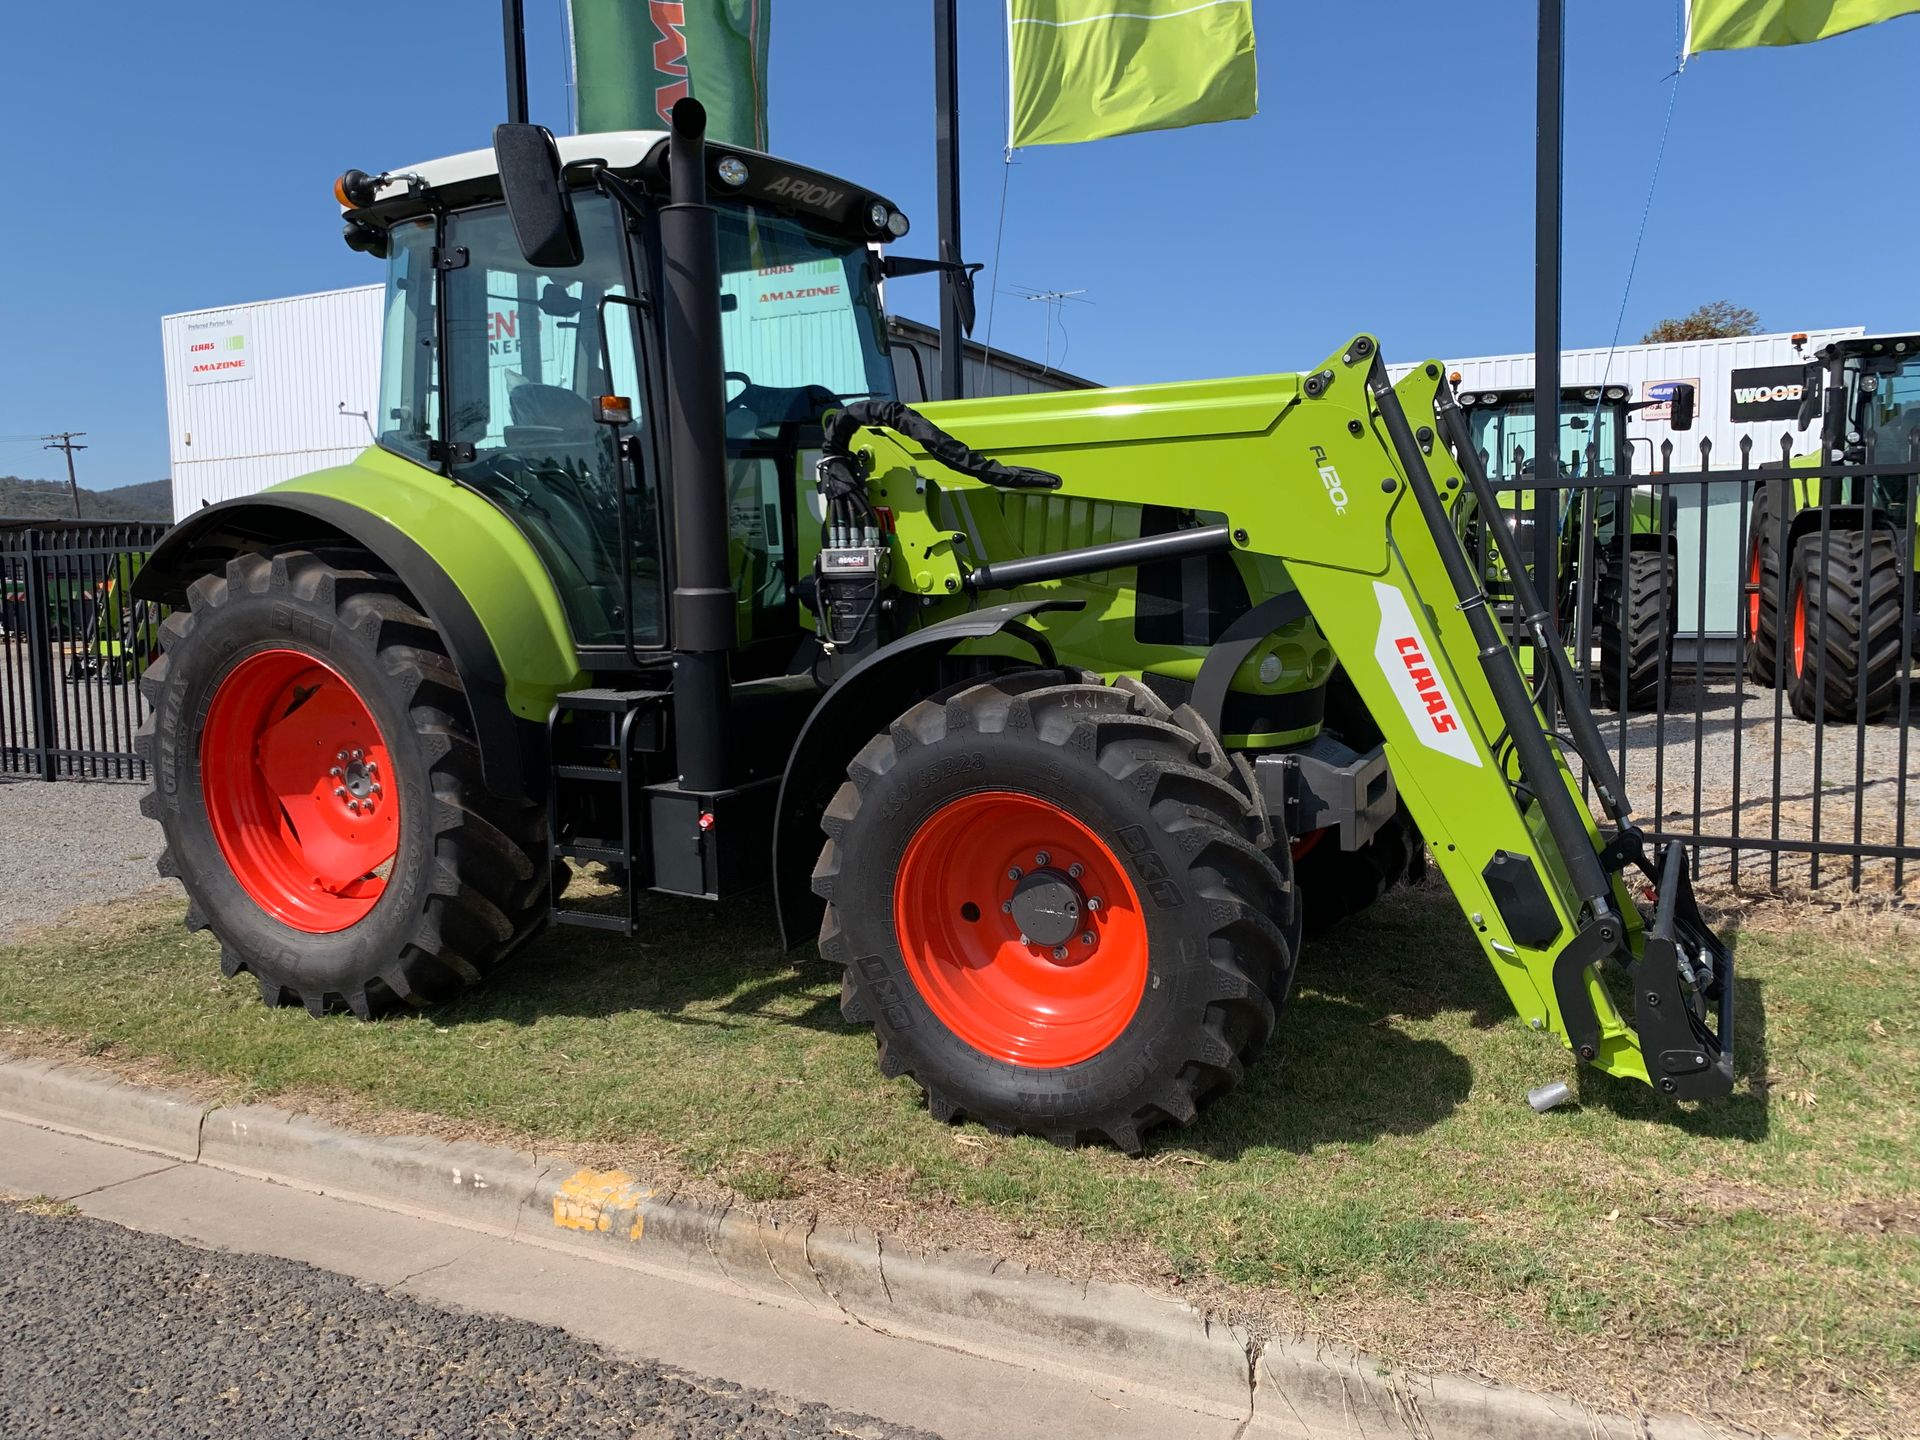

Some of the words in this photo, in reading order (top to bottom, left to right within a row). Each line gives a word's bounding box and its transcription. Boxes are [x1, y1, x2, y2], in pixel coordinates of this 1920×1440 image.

[763, 176, 845, 209] ARION
[759, 285, 841, 303] AMAZONE
[188, 322, 208, 331] Preferred
[209, 320, 225, 328] Partner
[190, 342, 215, 353] CLAAS
[192, 359, 246, 373] AMAZONE
[1394, 636, 1458, 733] CLAAS
